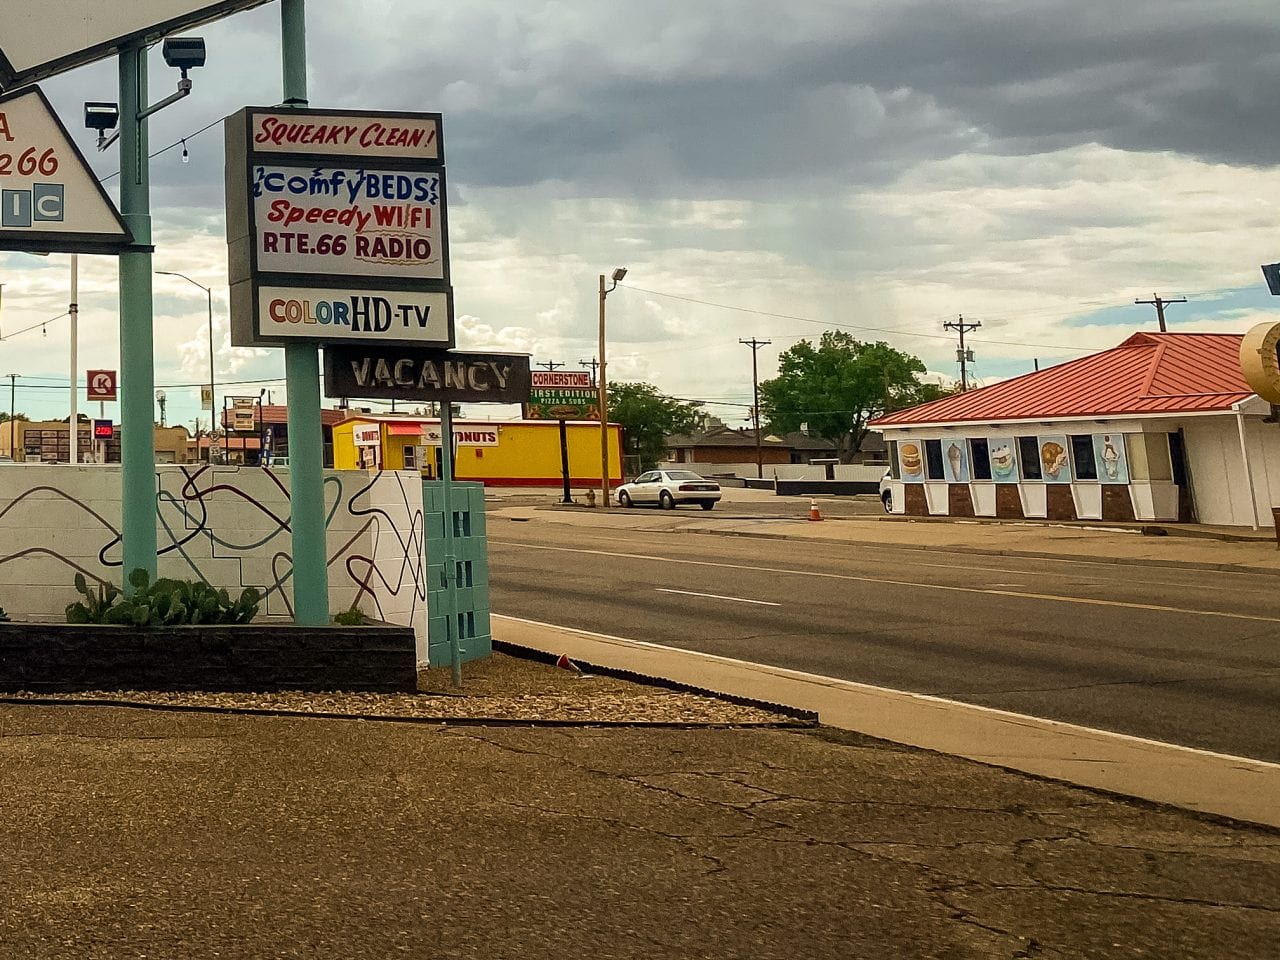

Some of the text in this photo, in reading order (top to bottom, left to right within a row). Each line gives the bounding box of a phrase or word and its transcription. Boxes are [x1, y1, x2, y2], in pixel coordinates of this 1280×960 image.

[255, 117, 435, 148] SQUEAKY CLEAN!
[17, 146, 59, 176] 66
[366, 174, 429, 201] BEDS
[267, 200, 371, 232] Speedy
[355, 235, 432, 260] RADIO
[350, 357, 514, 391] VACANCY
[532, 373, 588, 386] CORNERSTONE
[559, 390, 597, 399] EDITION
